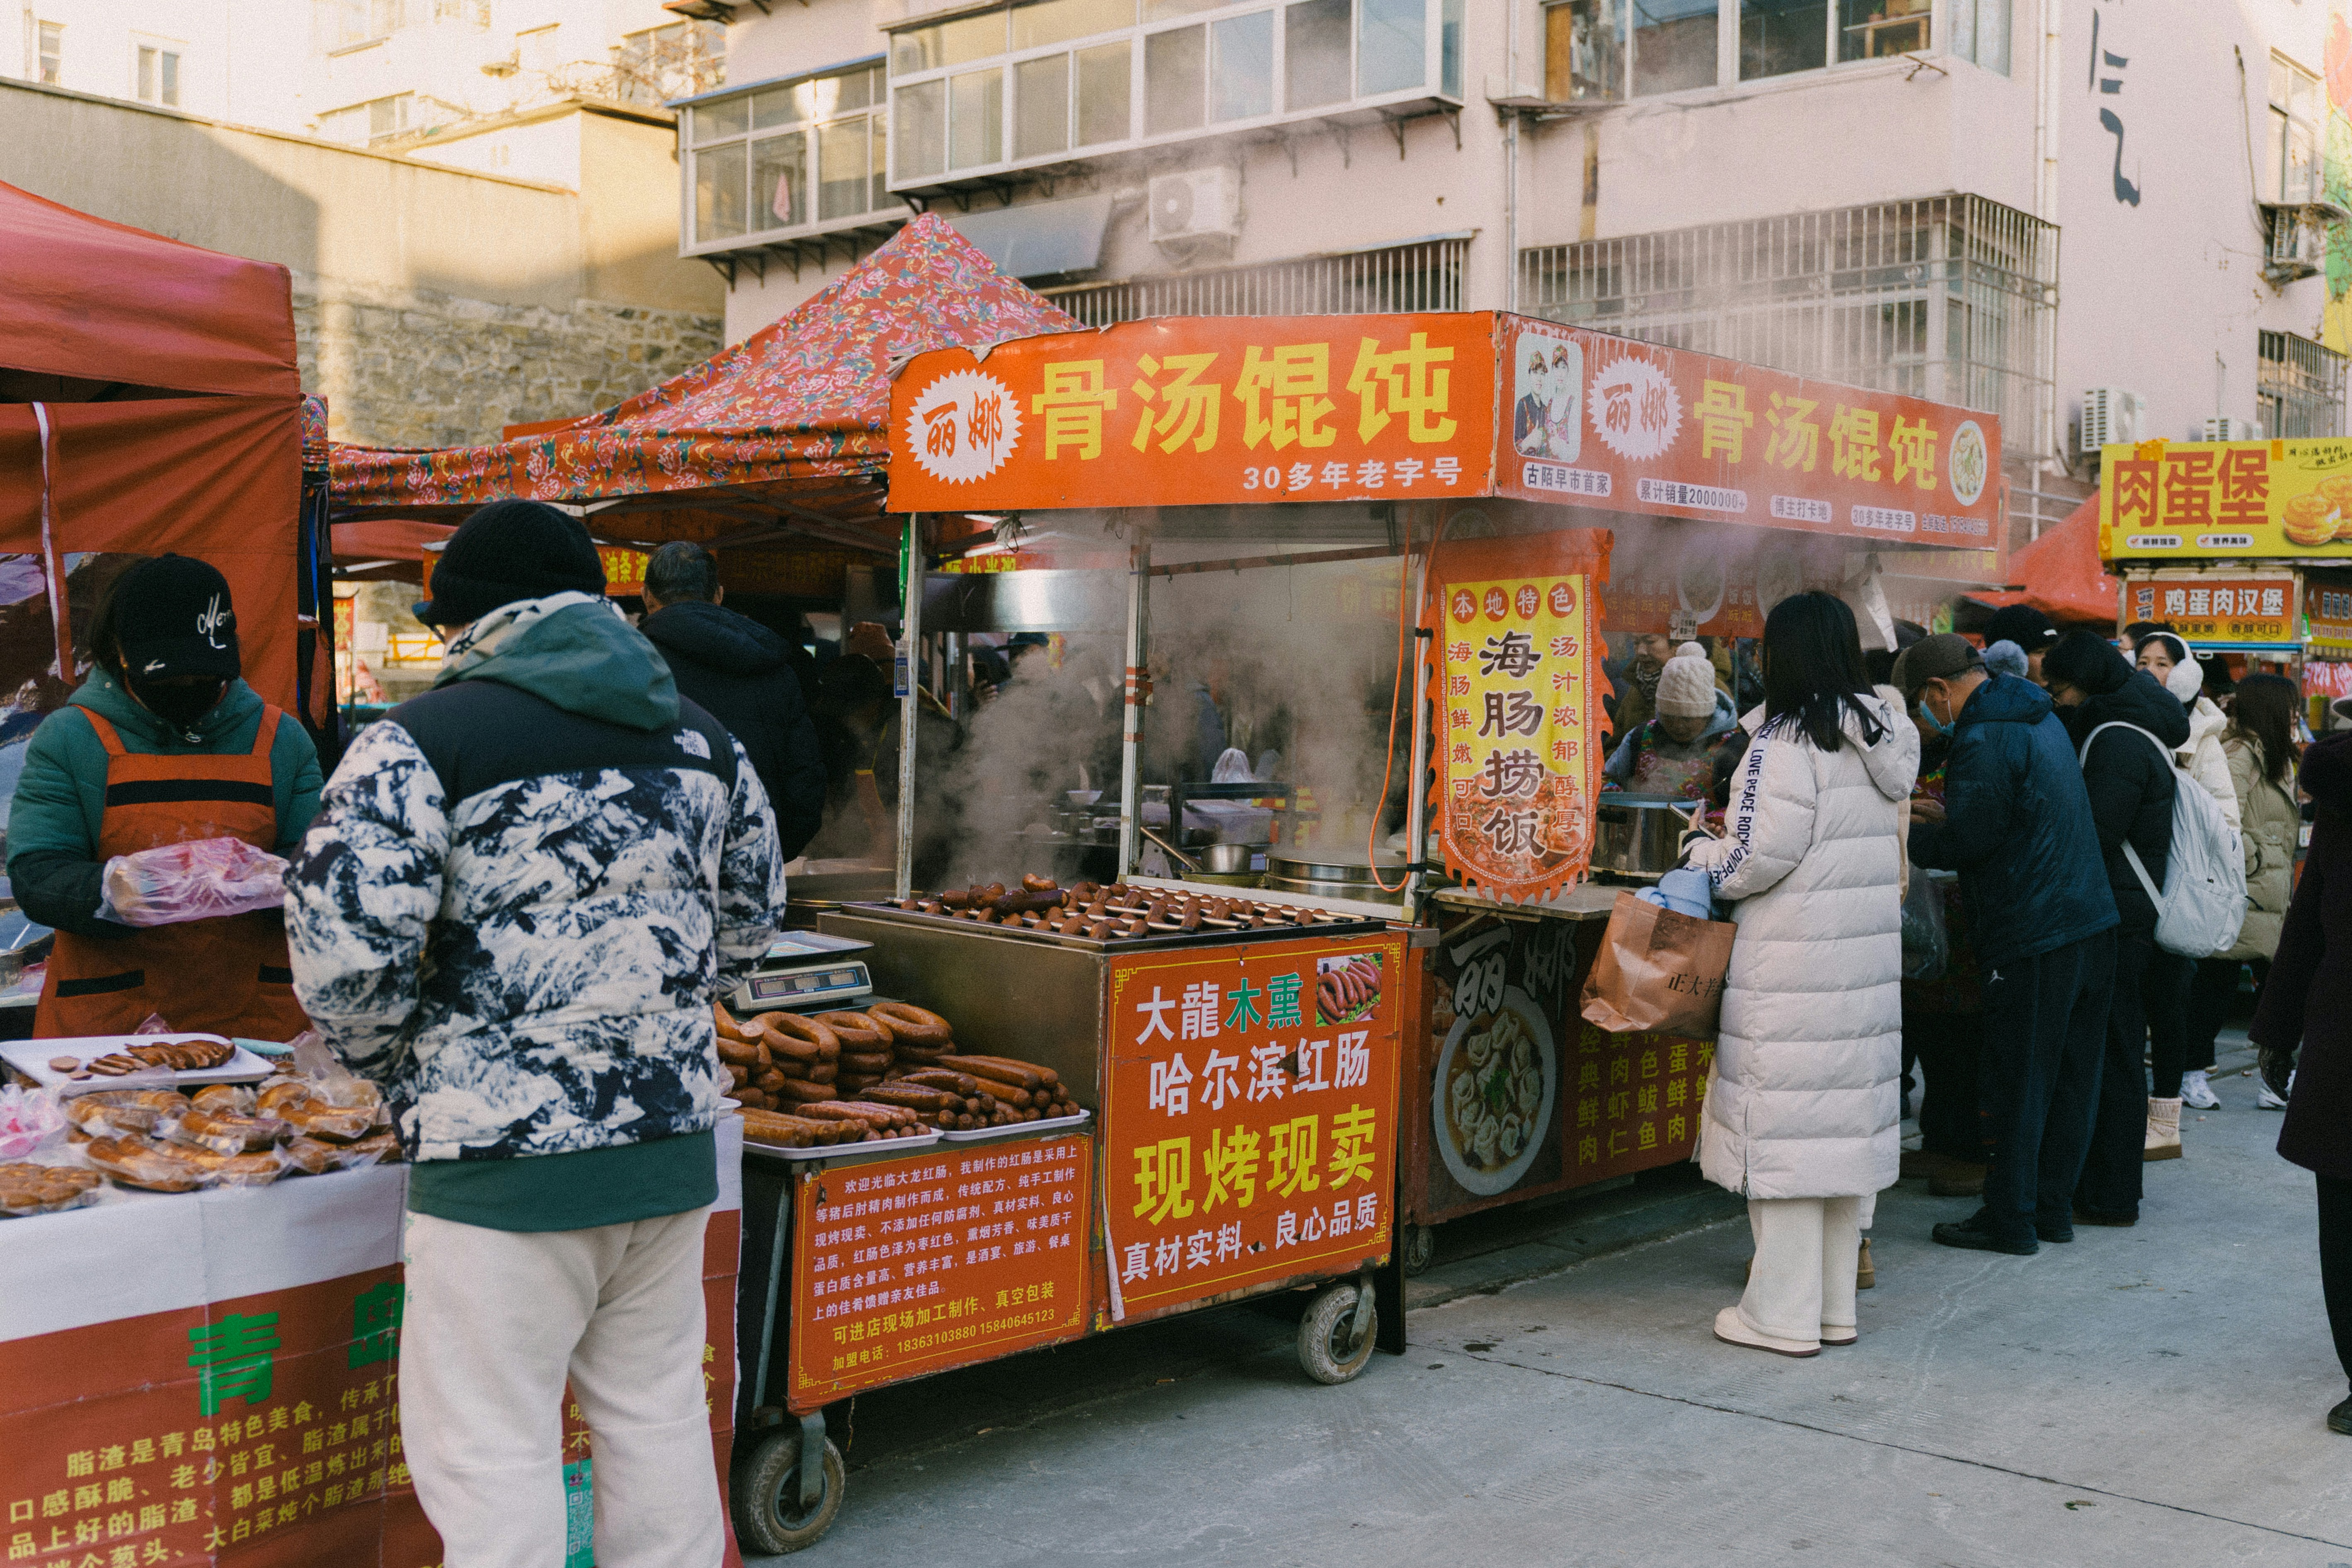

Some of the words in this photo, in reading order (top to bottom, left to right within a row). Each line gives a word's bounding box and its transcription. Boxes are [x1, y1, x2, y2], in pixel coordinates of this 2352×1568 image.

[1032, 332, 1457, 460] 骨汤馄饨
[1602, 381, 1668, 441] 丽娜
[925, 391, 1003, 468] 丽娜
[1693, 378, 1938, 490] 骨汤馄饨
[1244, 457, 1462, 491] 30多年老字号
[1527, 465, 1608, 494] 古陌早市首家
[1641, 480, 1745, 508] 累计销量2000000+
[2112, 448, 2269, 527] 肉蛋堡
[1775, 498, 1828, 521] 博主打卡地
[1853, 509, 1912, 531] 30多年老字号
[1453, 586, 1575, 616] 本地特色
[2164, 588, 2283, 616] 鸡蛋肉汉堡
[2170, 622, 2214, 634] 酥里嫩
[1449, 641, 1474, 831] 海肠鲜嫩可口
[1478, 630, 1545, 858] 海肠捞饭
[1550, 635, 1579, 830] 汤汁浓郁醇厚
[1749, 749, 1764, 776] LOVE
[1740, 779, 1758, 813] PEACE
[1729, 847, 1749, 869] LOV
[1735, 816, 1751, 847] ROCK
[1136, 972, 1303, 1045] 大龍木熏
[1150, 1030, 1369, 1117] 哈尔滨红肠
[1577, 1025, 1601, 1166] 经典鲜肉
[1638, 1034, 1659, 1151] 色鲅鱼
[1667, 1036, 1689, 1145] 蛋鲜肉
[845, 1145, 1077, 1194] 欢迎光临大龙红肠，我制作的红肠是采用上
[1134, 1103, 1376, 1226] 现烤现卖
[815, 1190, 1073, 1247] 现烤现卖、不添加任何防腐剂、真材实料、良心
[816, 1167, 1075, 1223] 等猪后肘精肉制作而成，传统配方、纯手工制作
[1122, 1192, 1377, 1284] 真材实料、良心品质
[813, 1281, 945, 1321] 上的佳肴馈赠亲友佳品。
[833, 1281, 1054, 1345] 可进店现场加工制作、真空包装
[981, 1309, 1054, 1334] 15840645123
[66, 1374, 396, 1477] 脂渣是青岛特色美食，传承了
[27, 1462, 411, 1568] 个葱头、大白菜炖个脂渣那绝
